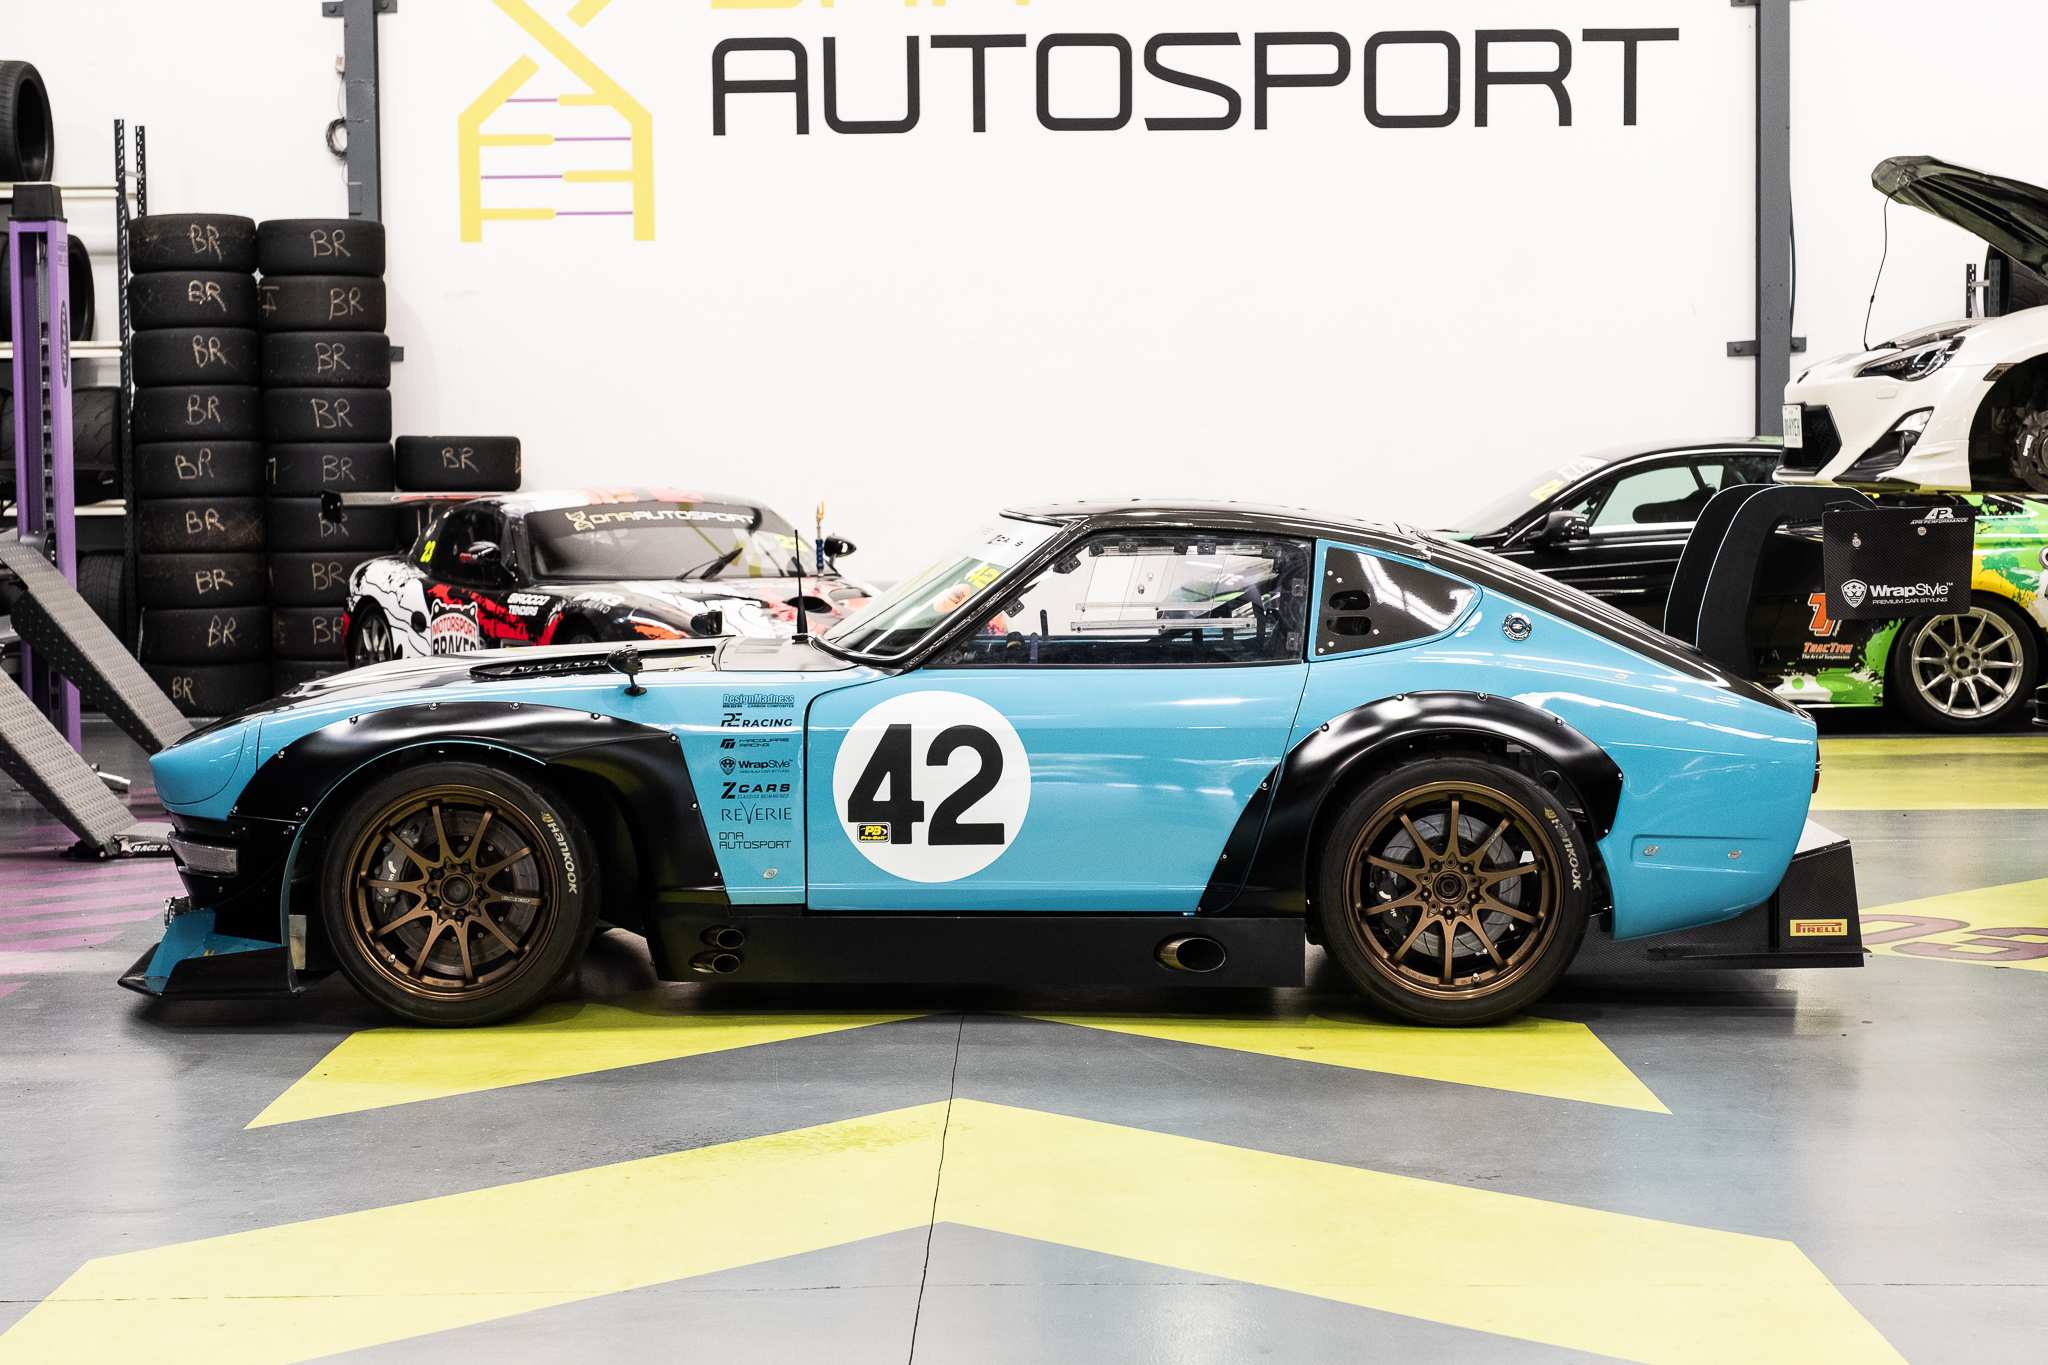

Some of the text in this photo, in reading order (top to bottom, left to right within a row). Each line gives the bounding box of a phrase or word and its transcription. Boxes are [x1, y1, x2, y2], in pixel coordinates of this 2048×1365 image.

[712, 28, 1680, 136] AUTOSPORT
[188, 223, 223, 262] BR
[310, 229, 351, 257] BR
[188, 279, 227, 312] BR
[329, 287, 364, 320] BR
[192, 335, 227, 368] BR
[315, 342, 351, 373] BR
[186, 394, 221, 425] BR
[311, 398, 353, 429] BR
[174, 448, 214, 480] BR
[321, 454, 356, 482] BR
[441, 447, 480, 473] BR
[185, 508, 225, 534] BR
[195, 568, 234, 594] BR
[311, 561, 346, 591] BR
[207, 614, 237, 648] BR
[432, 616, 477, 640] MOTORSPORT
[172, 676, 196, 705] BR
[742, 718, 793, 727] RACING
[738, 783, 791, 793] CARS
[847, 723, 1005, 846] 42
[721, 800, 792, 824] REVERIE
[133, 844, 160, 852] RACE
[719, 831, 744, 840] DNA
[719, 840, 792, 850] AUTOSPORT
[1795, 922, 1843, 933] PIRELLI
